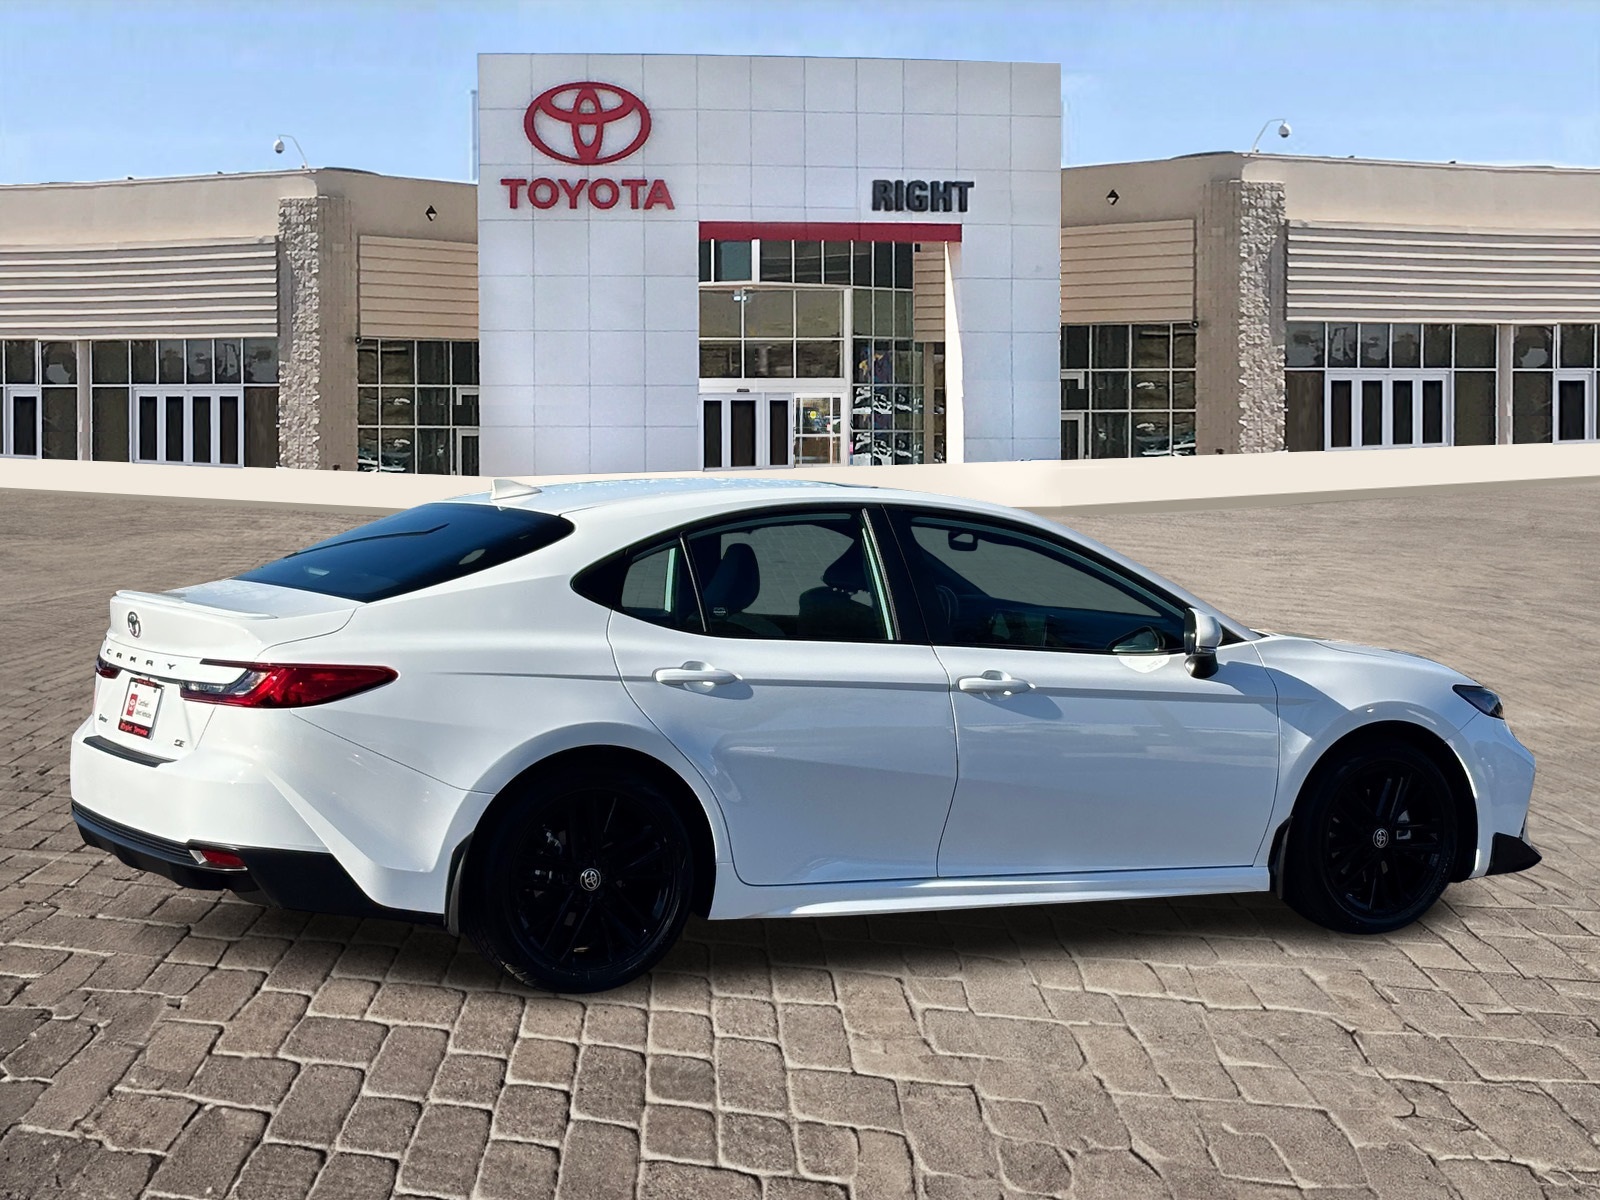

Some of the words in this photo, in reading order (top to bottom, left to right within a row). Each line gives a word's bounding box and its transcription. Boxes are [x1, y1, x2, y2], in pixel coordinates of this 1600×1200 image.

[500, 178, 675, 210] TOYOTA
[872, 179, 976, 212] RIGHT
[106, 648, 176, 669] CAMRY
